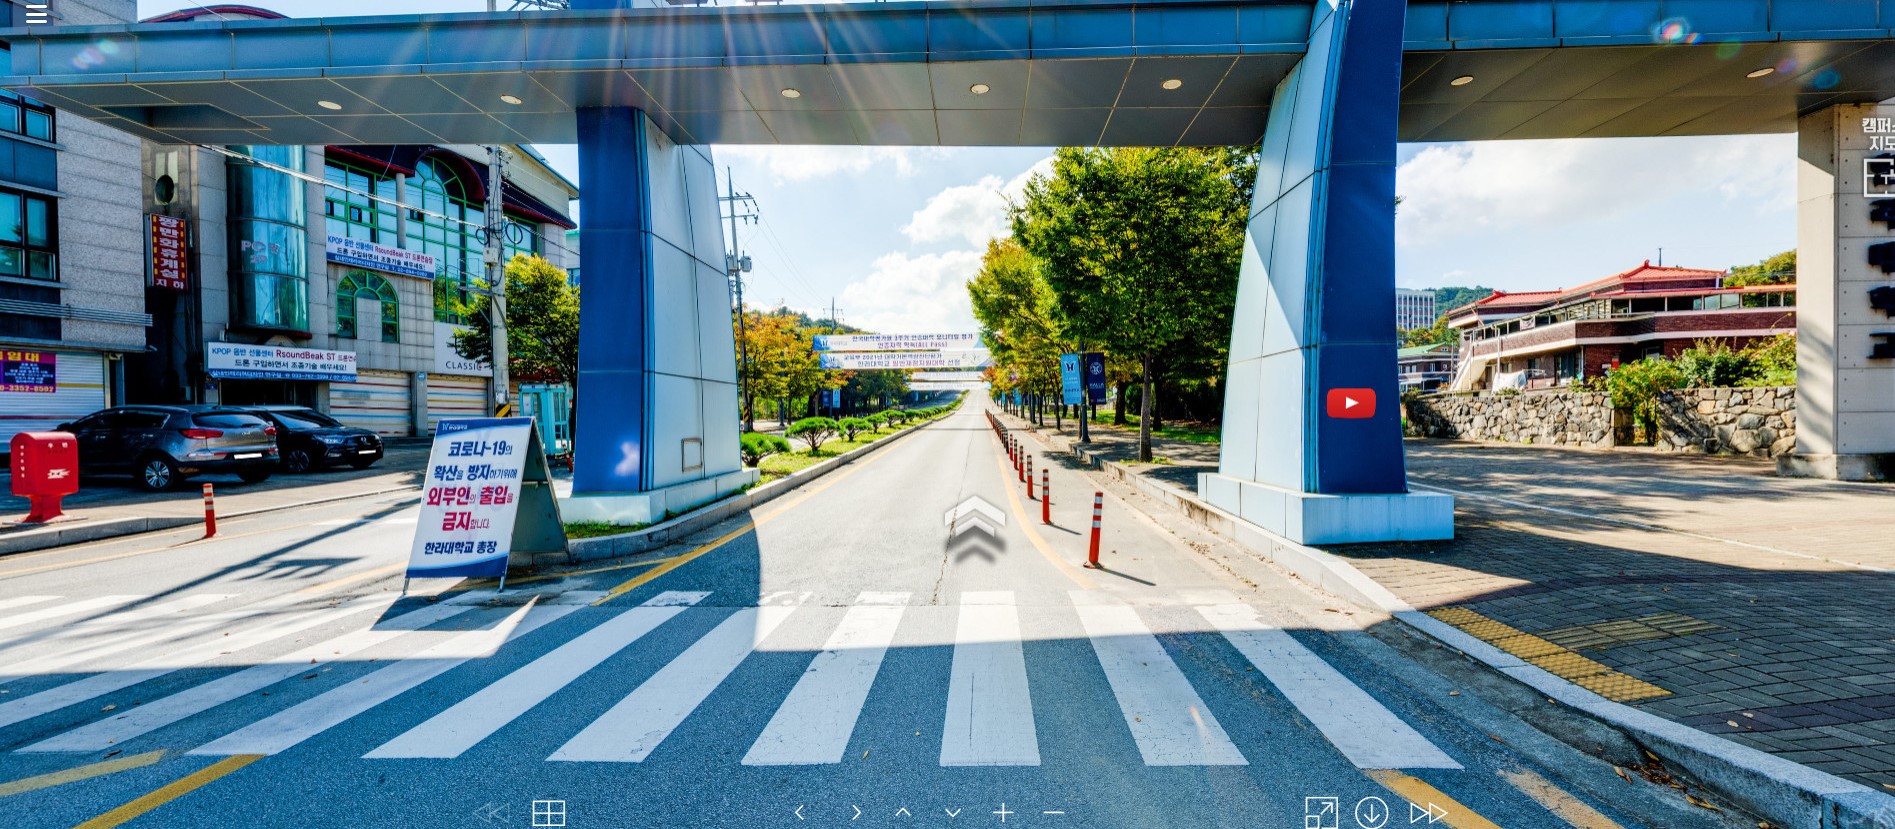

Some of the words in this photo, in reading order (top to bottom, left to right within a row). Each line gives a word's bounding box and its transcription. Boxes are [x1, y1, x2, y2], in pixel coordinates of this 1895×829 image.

[327, 235, 342, 245] KPOP
[374, 245, 404, 258] RsoundBeak
[336, 247, 349, 255] 드론
[350, 249, 379, 262] 구입하면서
[403, 260, 426, 270] 배우세요!
[276, 349, 324, 360] RsoundBeak
[235, 359, 250, 367] 드론
[252, 360, 289, 368] 구입하면서
[291, 362, 317, 370] 조종기술
[320, 363, 347, 371] 배우세요!
[448, 440, 513, 457] 코로나-19의
[434, 465, 463, 481] 확산을
[467, 464, 517, 481] 방지하기위해
[427, 487, 476, 506] 외부인의
[479, 485, 513, 505] 출입을
[424, 541, 474, 555] 한라대학교
[476, 541, 497, 554] 총장
